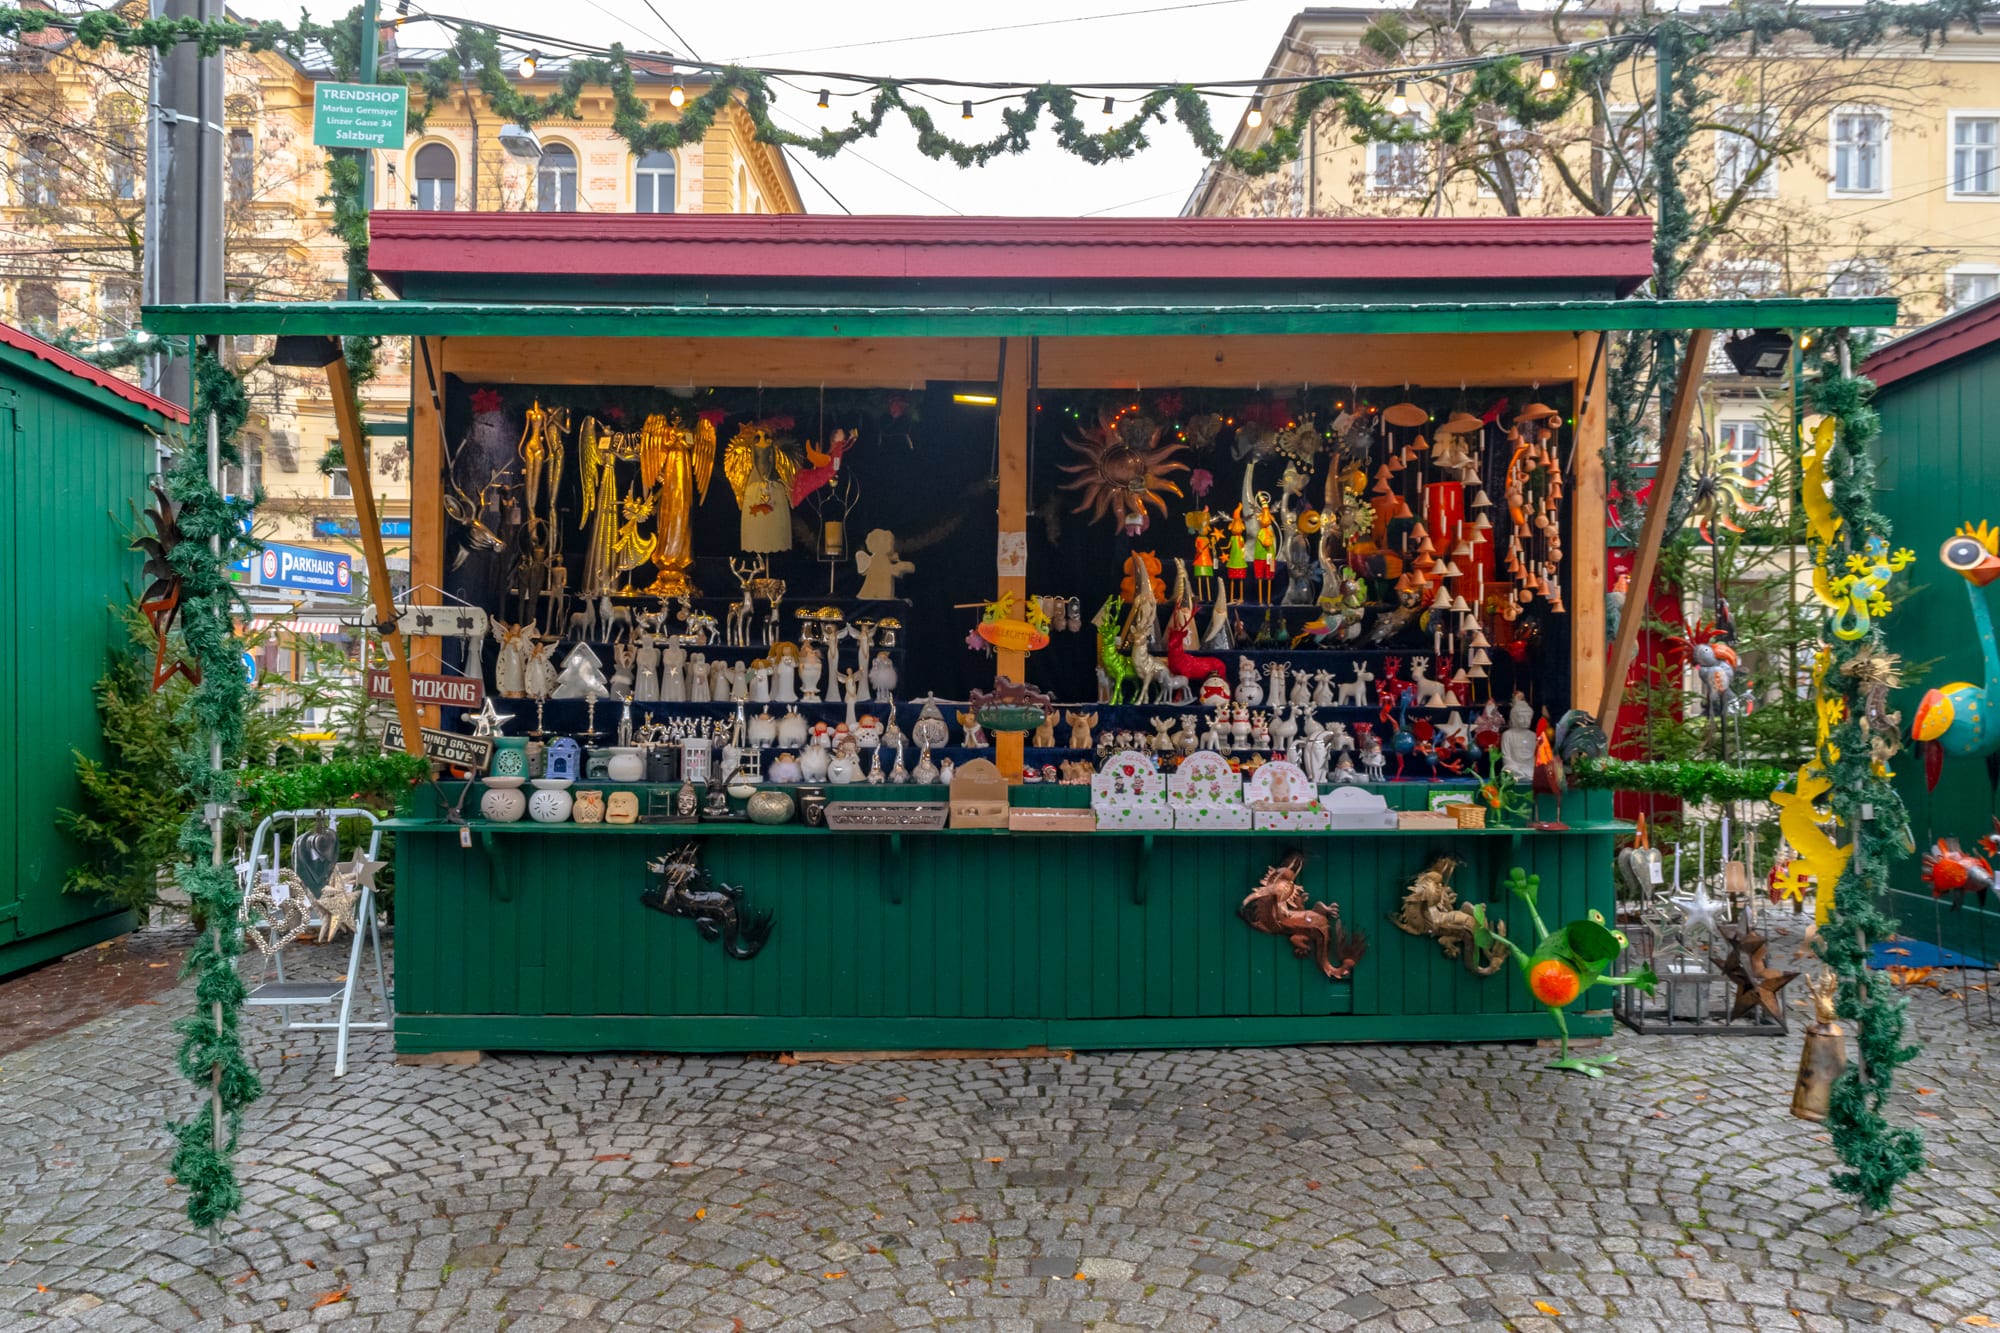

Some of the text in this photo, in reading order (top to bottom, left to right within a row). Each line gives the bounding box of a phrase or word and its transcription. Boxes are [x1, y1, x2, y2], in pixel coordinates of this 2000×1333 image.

[322, 89, 400, 103] TRENDSHOP
[322, 104, 398, 117] Markus Germayer
[326, 117, 392, 128] Linzer Gasse 34
[336, 129, 385, 144] Salzburg
[281, 552, 335, 581] PARKHAUS
[373, 675, 477, 701] NO MOKING
[436, 746, 473, 763] LOVE
